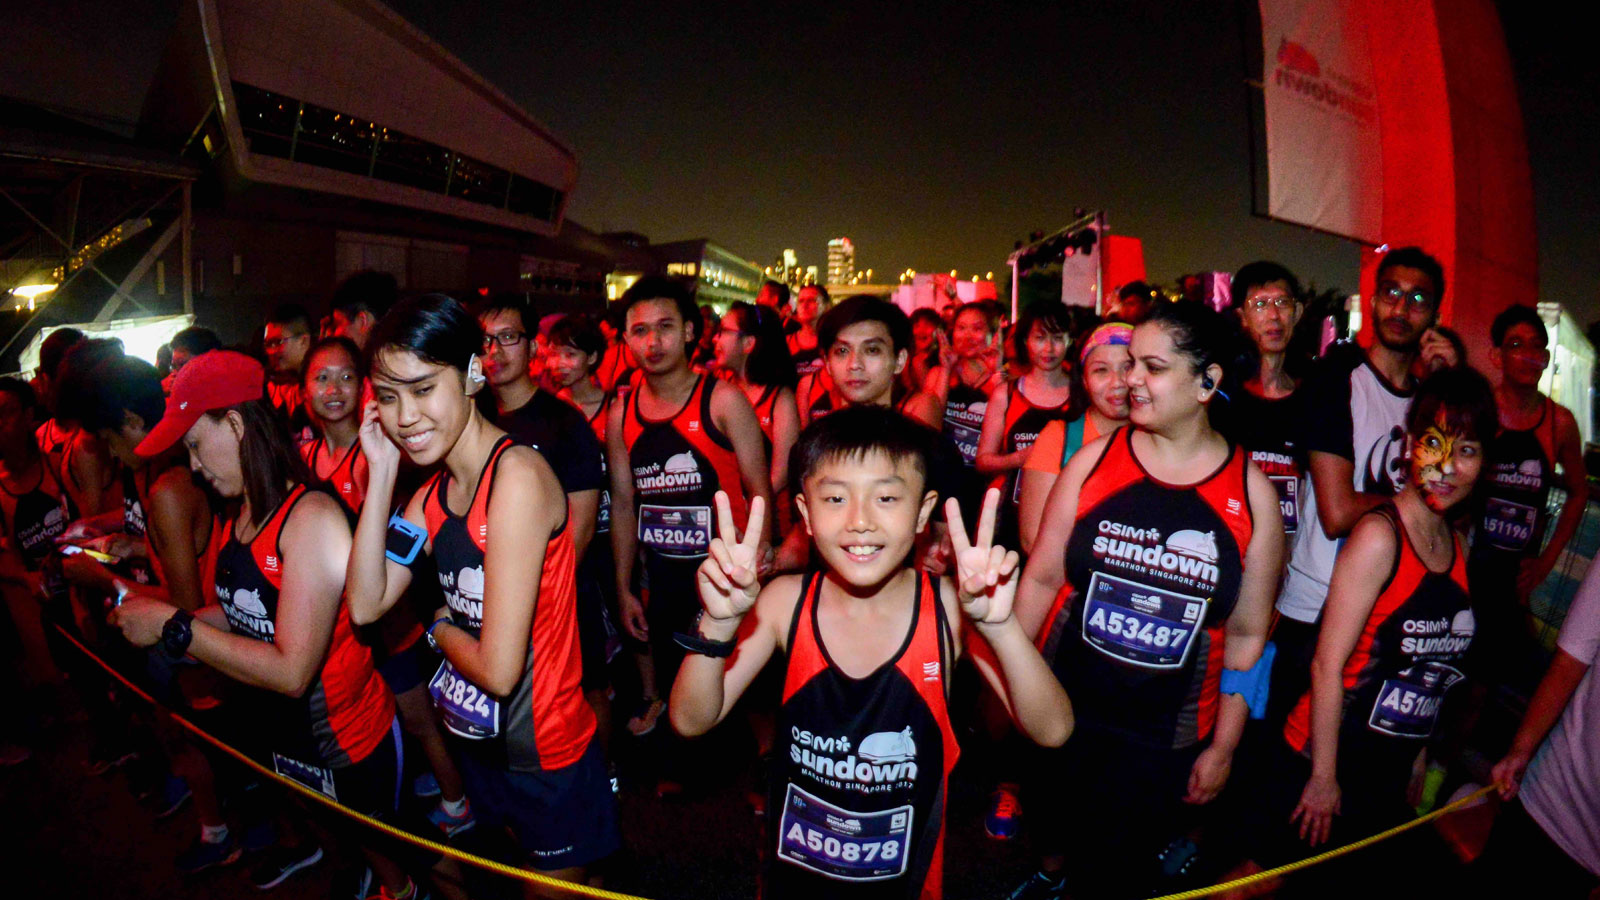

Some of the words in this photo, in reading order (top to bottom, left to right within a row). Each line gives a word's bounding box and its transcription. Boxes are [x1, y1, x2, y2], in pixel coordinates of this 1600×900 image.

[946, 408, 984, 423] undow
[1496, 471, 1541, 488] ndown
[643, 528, 706, 544] A52042
[1099, 520, 1145, 541] OSIM
[1093, 536, 1220, 583] sundown
[1104, 557, 1146, 573] MARATHON
[1149, 568, 1194, 586] SINGAPORE
[1196, 581, 1215, 592] 2017
[1088, 607, 1188, 648] A53487
[1402, 619, 1441, 633] OSIM
[1381, 687, 1441, 717] A510
[791, 725, 835, 754] OSIM
[790, 743, 918, 783] sundown
[801, 767, 842, 790] MARATHON
[845, 782, 892, 795] SINGAPORE
[787, 822, 900, 862] A50878
